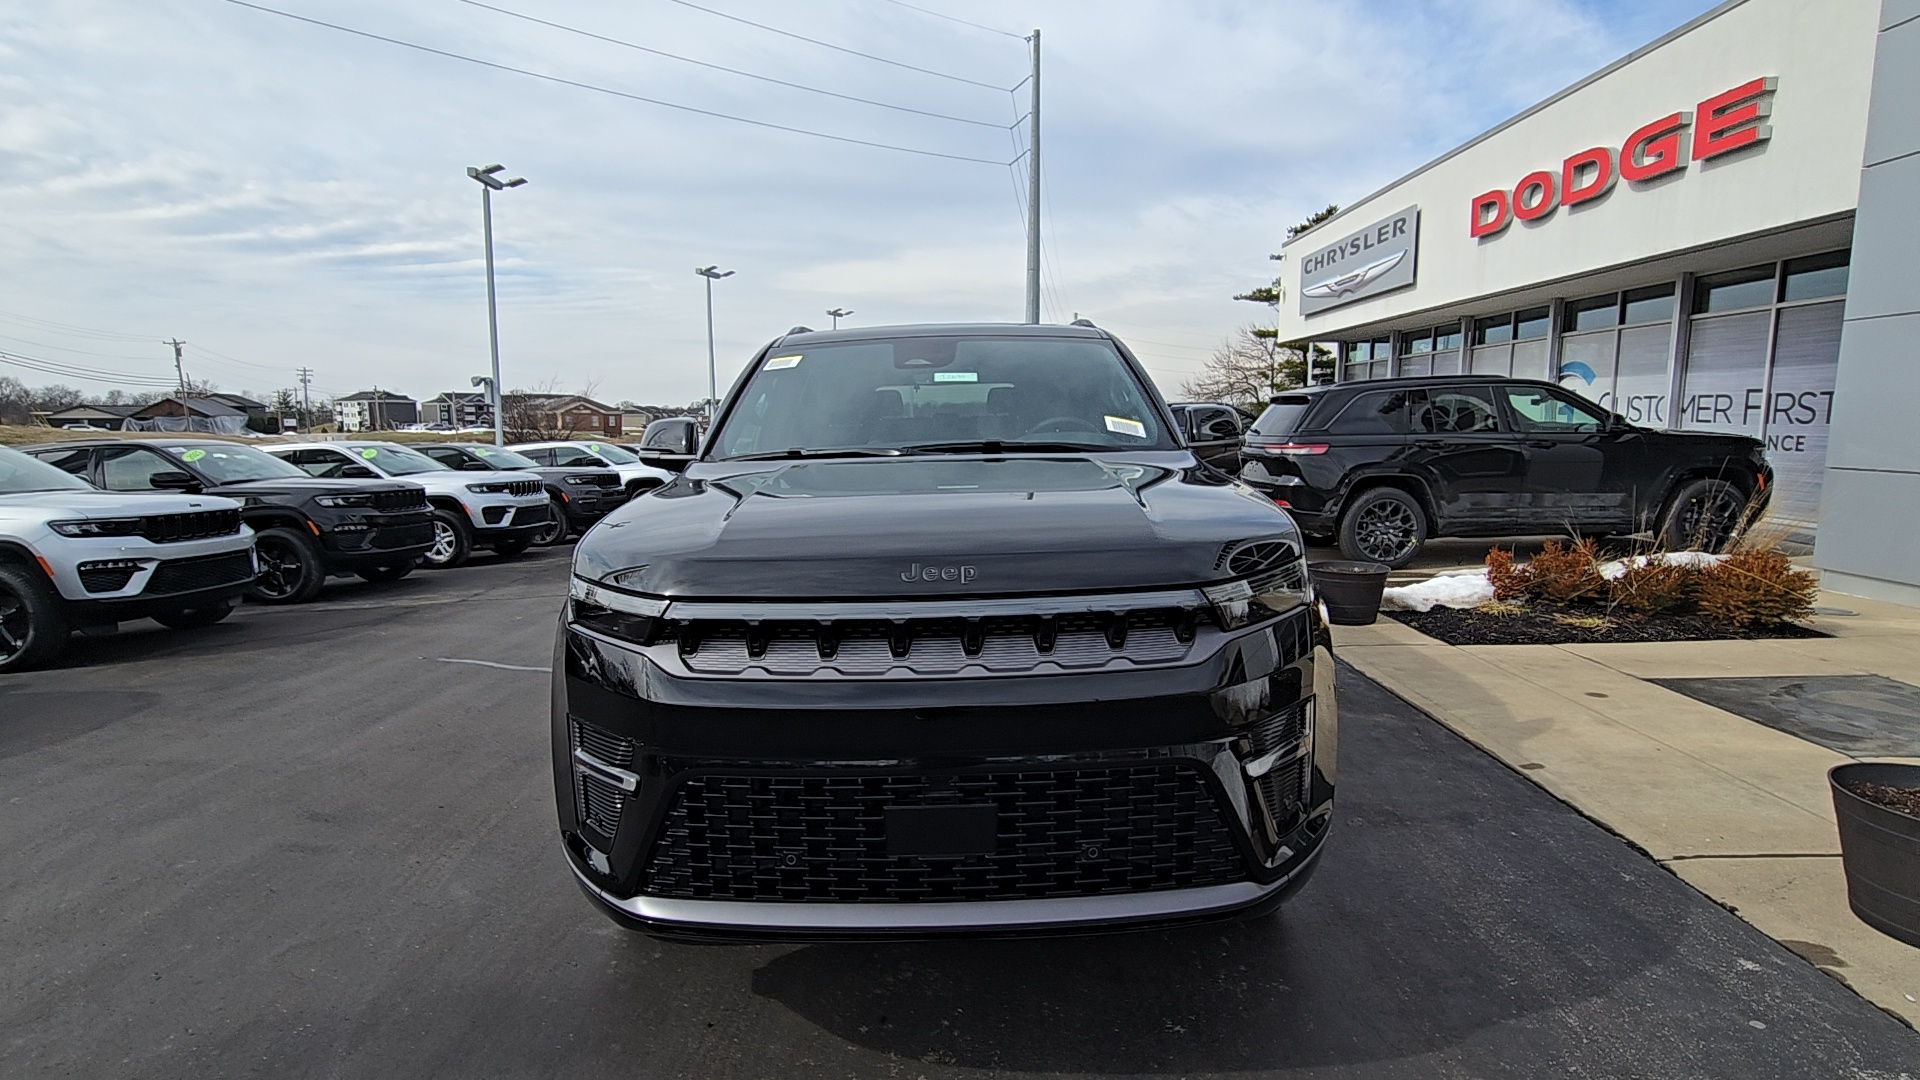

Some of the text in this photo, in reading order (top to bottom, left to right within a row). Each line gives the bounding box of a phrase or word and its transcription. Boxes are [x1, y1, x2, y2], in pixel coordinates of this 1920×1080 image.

[1470, 76, 1774, 239] DODGE
[1303, 217, 1407, 275] CHRYSLER
[900, 562, 977, 585] Jeep
